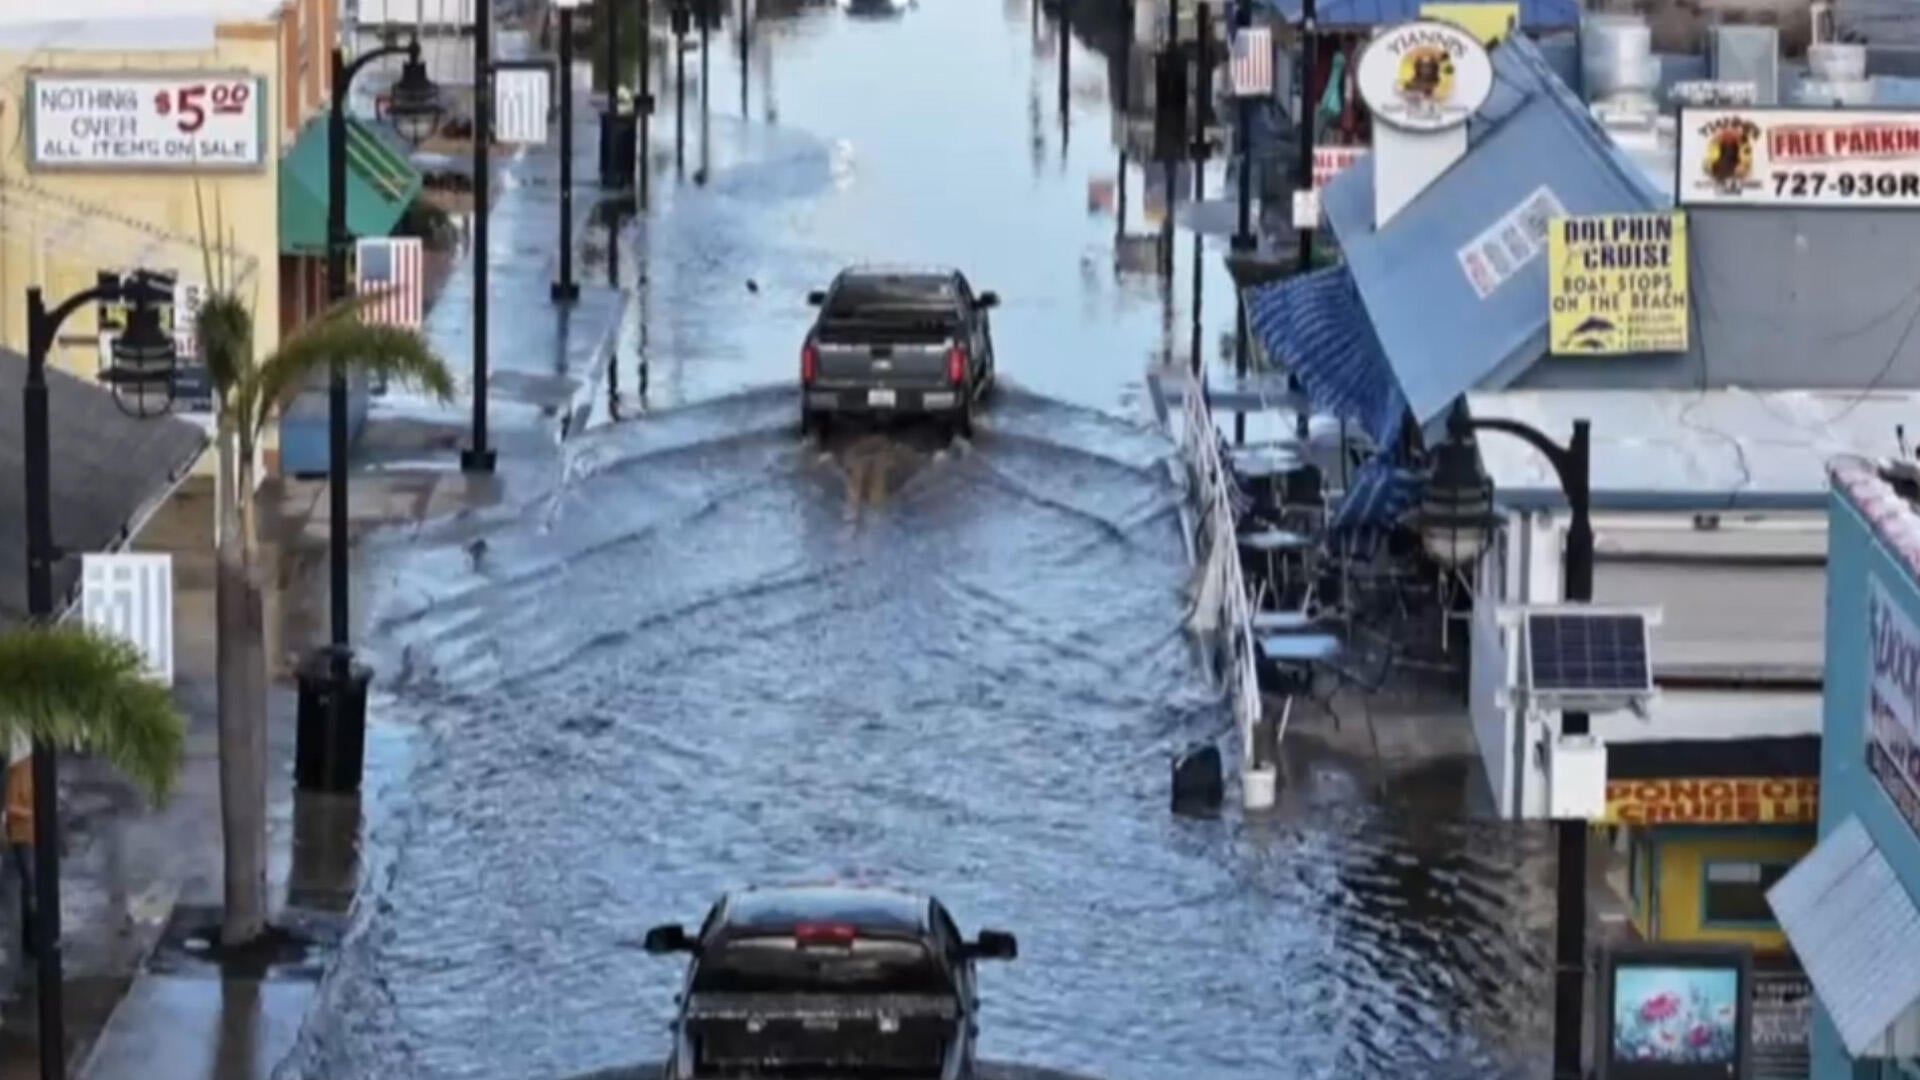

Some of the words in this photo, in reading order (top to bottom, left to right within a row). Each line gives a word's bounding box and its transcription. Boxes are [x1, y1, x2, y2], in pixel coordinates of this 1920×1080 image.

[40, 87, 138, 112] NOTHING
[70, 115, 138, 139] OVER
[43, 139, 81, 156] ALL
[92, 139, 160, 156] ITEMS
[164, 139, 195, 156] ON
[199, 138, 247, 157] SALE
[1774, 129, 1826, 157] FREE
[1564, 217, 1672, 243] DOLPHIN
[1584, 243, 1669, 270] CRUISE
[1563, 275, 1606, 294] BOAT
[1617, 272, 1673, 292] STOPS
[1553, 295, 1579, 312] ON
[1588, 292, 1620, 311] THE
[1629, 290, 1685, 309] BEACH
